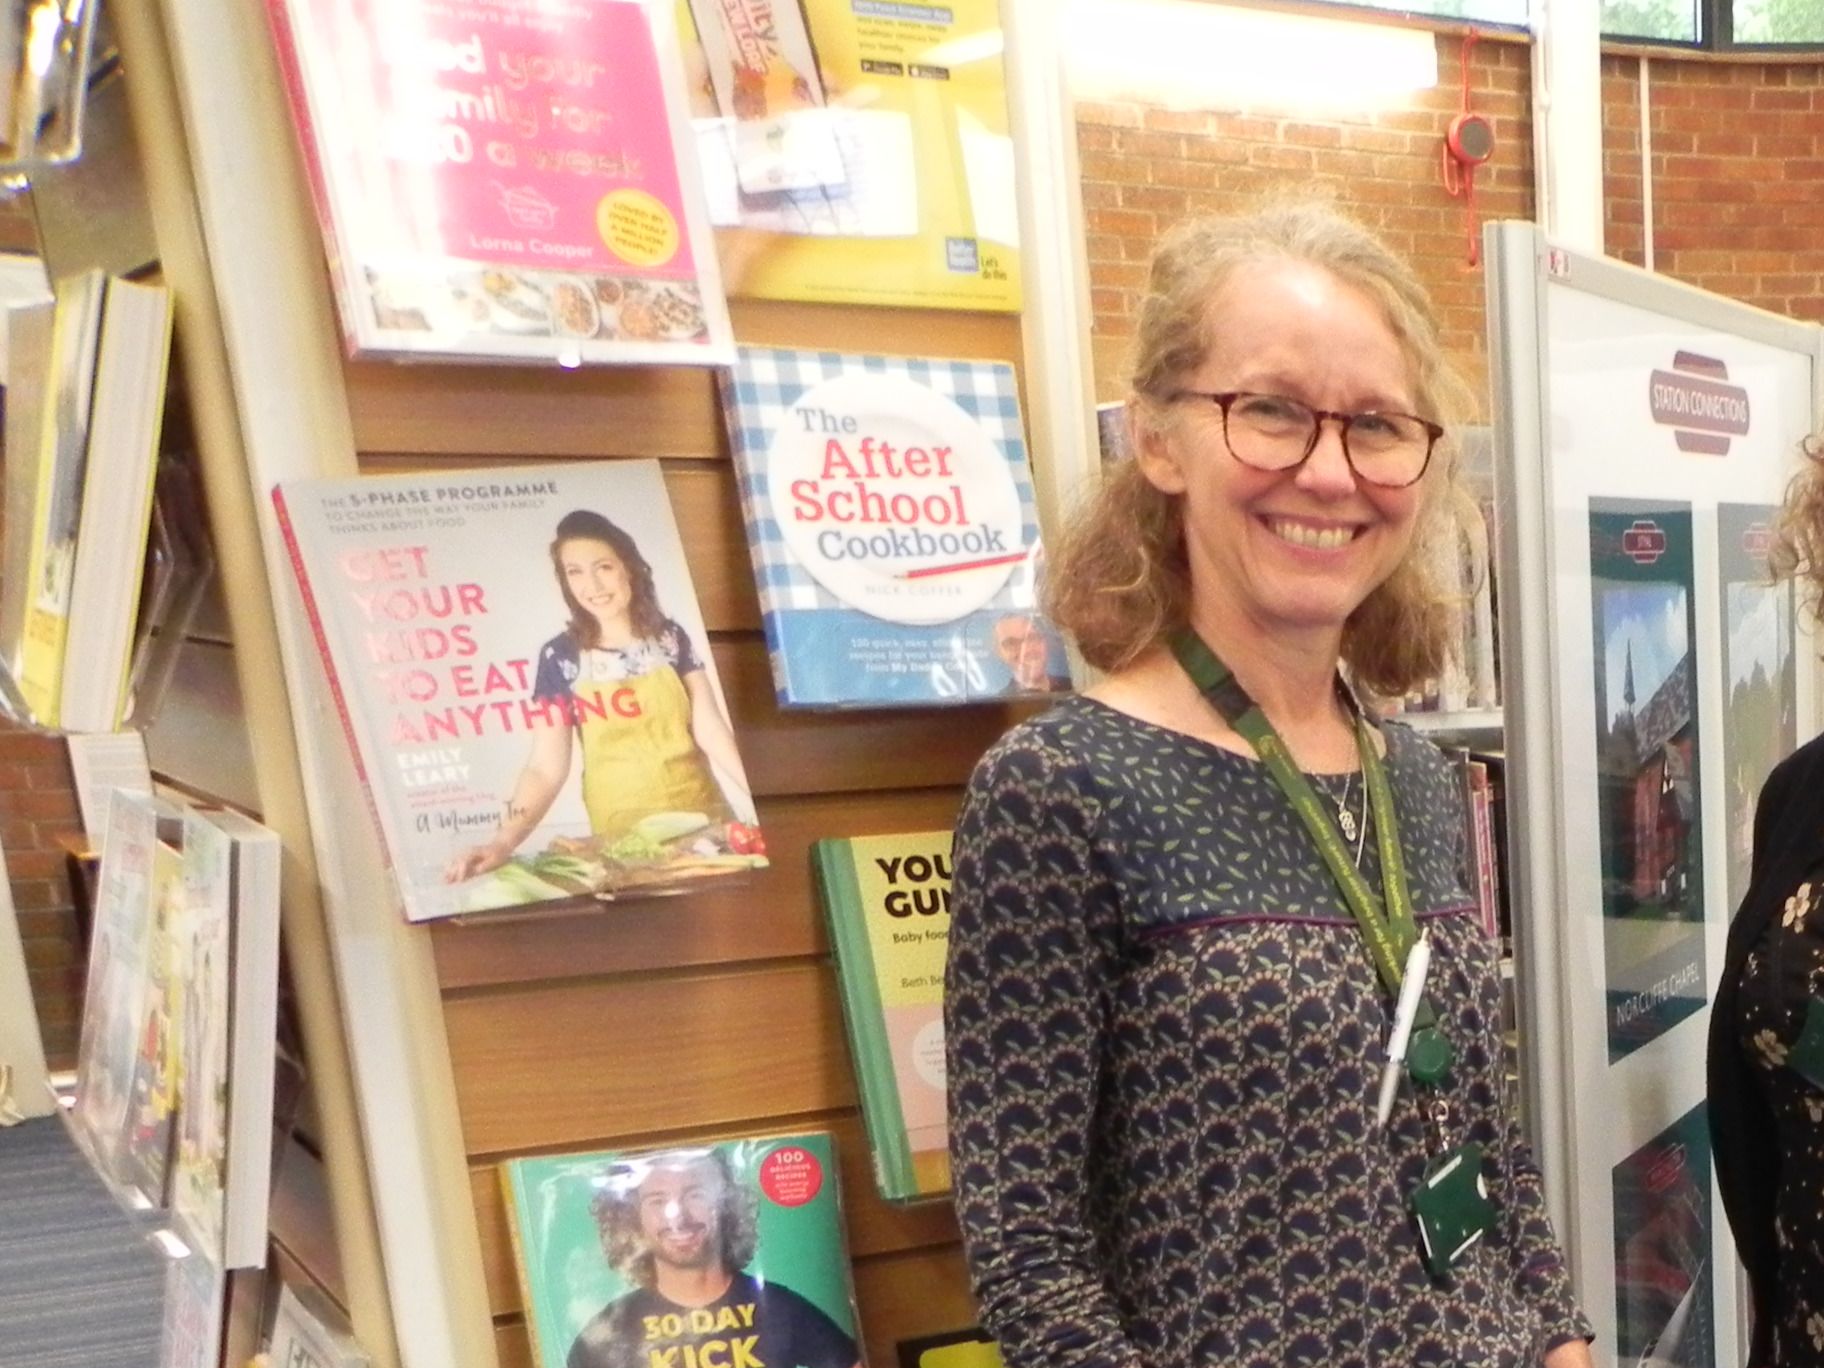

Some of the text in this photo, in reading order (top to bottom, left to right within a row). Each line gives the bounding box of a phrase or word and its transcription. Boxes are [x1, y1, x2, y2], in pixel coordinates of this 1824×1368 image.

[499, 50, 607, 90] your
[486, 142, 518, 168] a
[532, 148, 644, 181] week
[471, 232, 593, 260] Lorna Cooper
[1653, 382, 1747, 425] STATION CONNECTIONS
[797, 407, 858, 435] The
[820, 438, 954, 480] After
[349, 490, 431, 507] 5-PHASE
[436, 481, 559, 501] PROGRAMME
[790, 479, 970, 526] School
[348, 507, 402, 522] CHANGE
[434, 503, 461, 515] WAY
[465, 501, 499, 513] YOUR
[502, 499, 545, 511] FAMILY
[381, 519, 424, 532] ABOUT
[428, 516, 466, 529] FOOD
[817, 524, 1008, 561] Cookbook
[343, 546, 429, 583] GET
[354, 583, 489, 623] YOUR
[367, 624, 479, 664] KIDS
[381, 659, 531, 704] TO EAT
[390, 687, 643, 745] ANYTHING
[397, 747, 463, 770] EMILY
[401, 764, 472, 788] LEARY
[438, 808, 502, 833] Mummy
[875, 854, 952, 885] YOU
[884, 888, 951, 918] GU
[893, 931, 923, 945] Baby
[901, 976, 928, 988] Beth
[1616, 961, 1700, 1028] NORCLIFFE CHAPEL
[775, 1150, 804, 1164] 100
[691, 1303, 757, 1336] DAY
